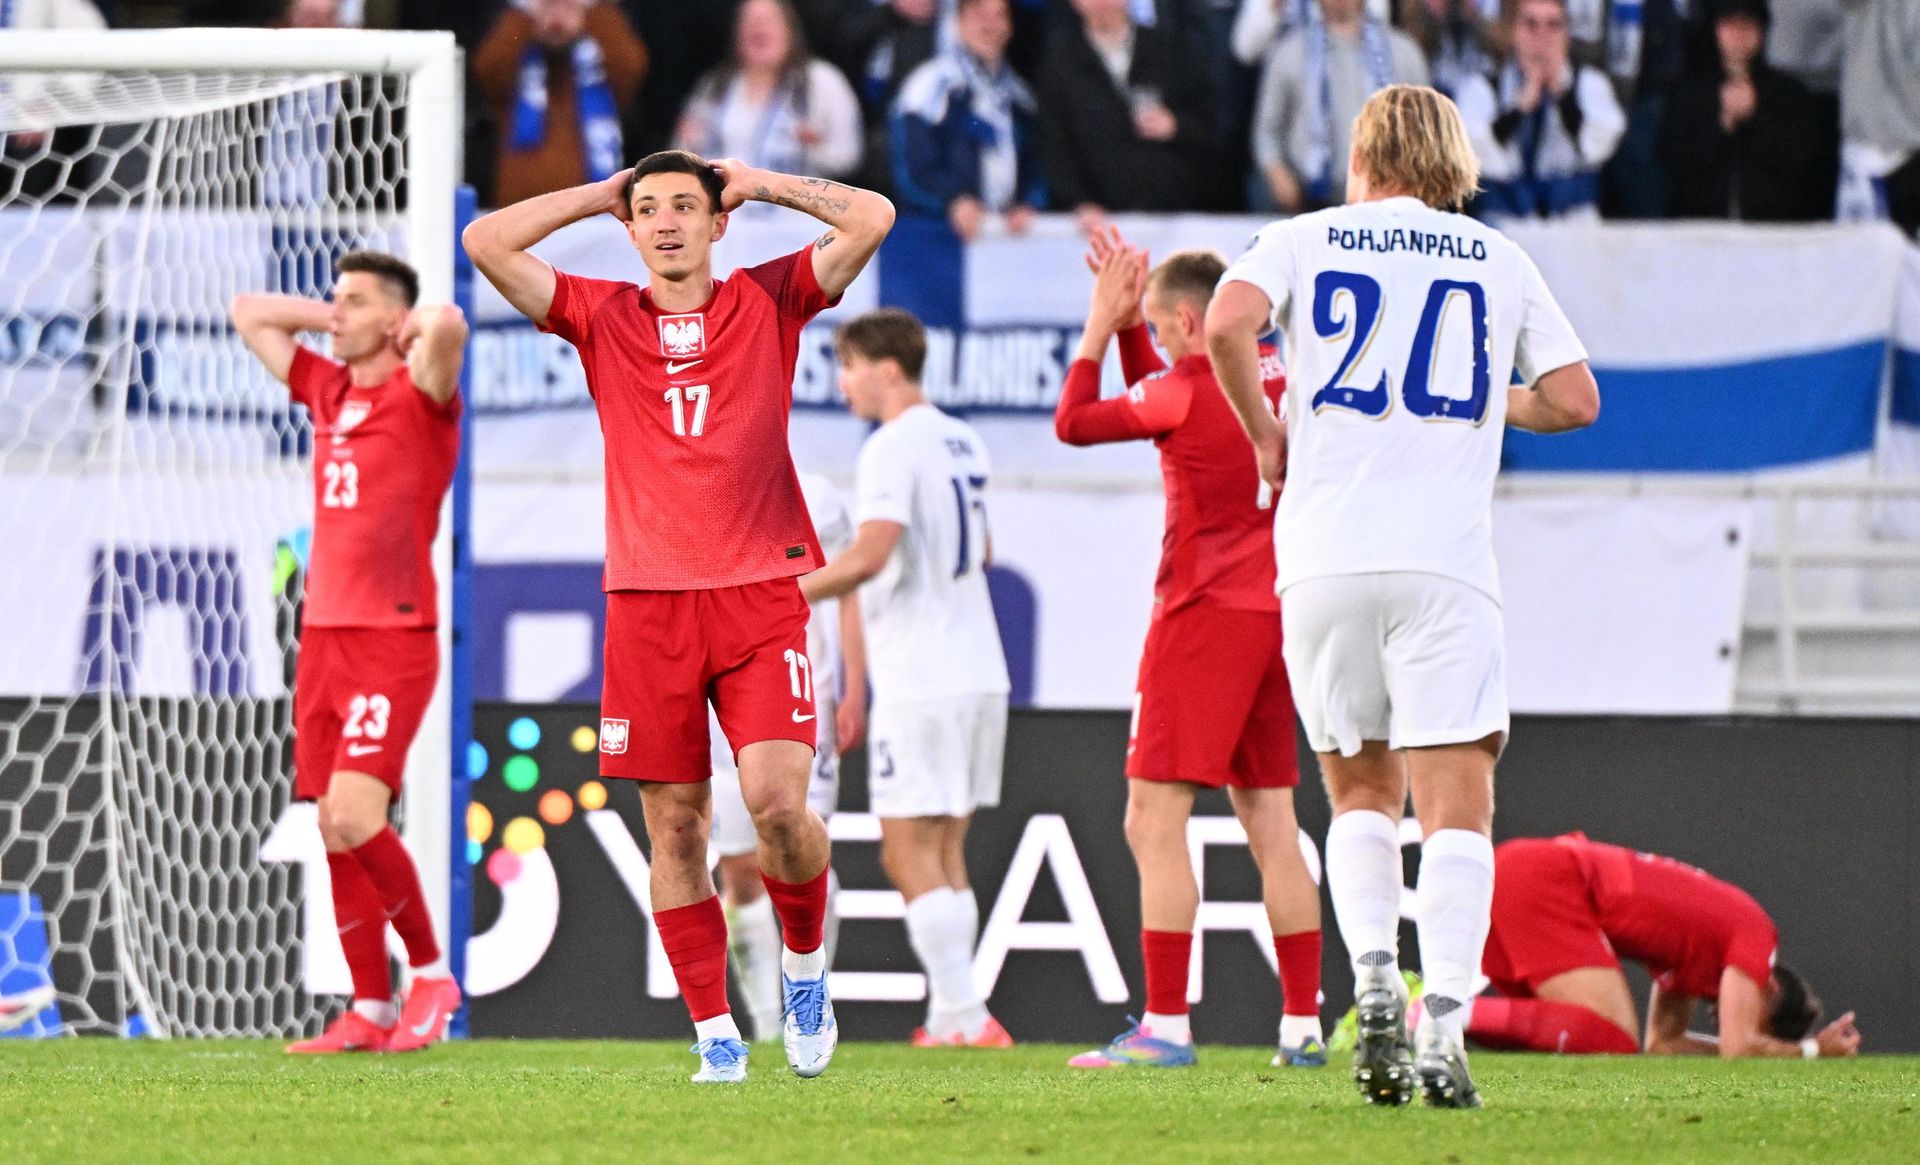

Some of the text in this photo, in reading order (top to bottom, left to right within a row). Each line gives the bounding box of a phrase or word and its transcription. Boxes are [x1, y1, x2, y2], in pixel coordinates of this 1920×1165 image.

[1327, 227, 1487, 261] POHJANPALO
[1312, 269, 1493, 428] 20
[663, 384, 711, 437] 17
[323, 460, 359, 509] 23
[783, 648, 812, 702] 17
[342, 693, 391, 740] 23
